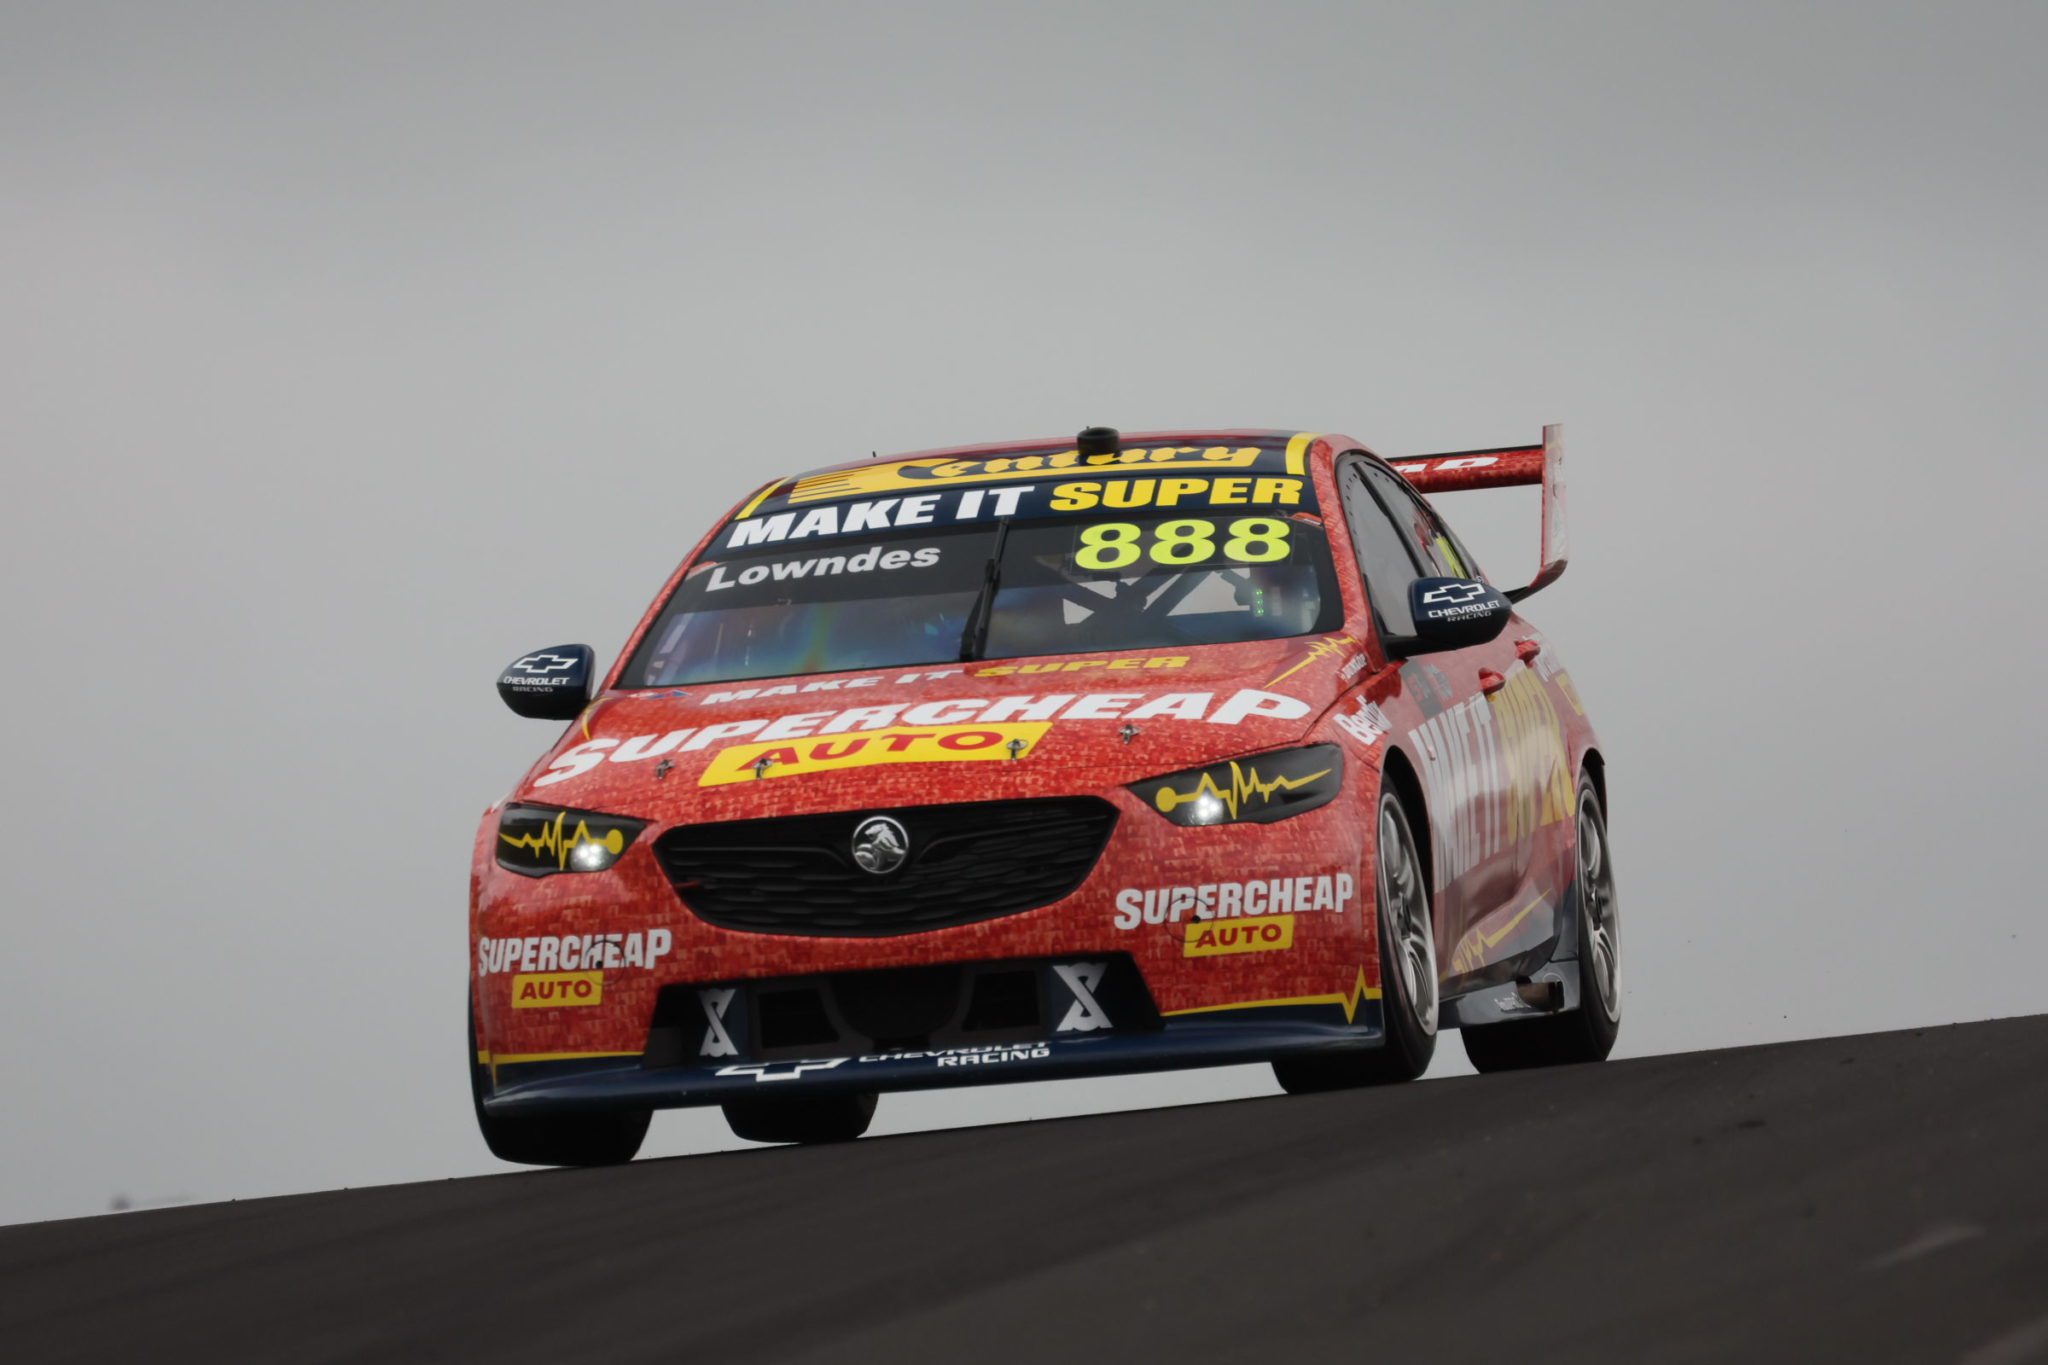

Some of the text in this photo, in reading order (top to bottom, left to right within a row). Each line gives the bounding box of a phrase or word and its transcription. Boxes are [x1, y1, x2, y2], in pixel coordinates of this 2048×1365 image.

[727, 478, 1303, 548] MAKE IT SUPER
[1074, 517, 1292, 571] 888
[705, 546, 941, 592] Lowndes
[1427, 599, 1501, 619] CHEVROLET
[502, 675, 571, 687] CHEVROLET
[700, 656, 1190, 706] MAKE IT SUPER
[532, 687, 1312, 788] SUPERCHEAP
[733, 727, 1005, 774] AUTO
[1113, 872, 1354, 932] SUPERCHEAP
[478, 928, 673, 976] SUPERCHEAP
[1195, 920, 1286, 949] AUTO
[520, 980, 593, 1002] AUTO
[937, 1046, 1051, 1068] RACING
